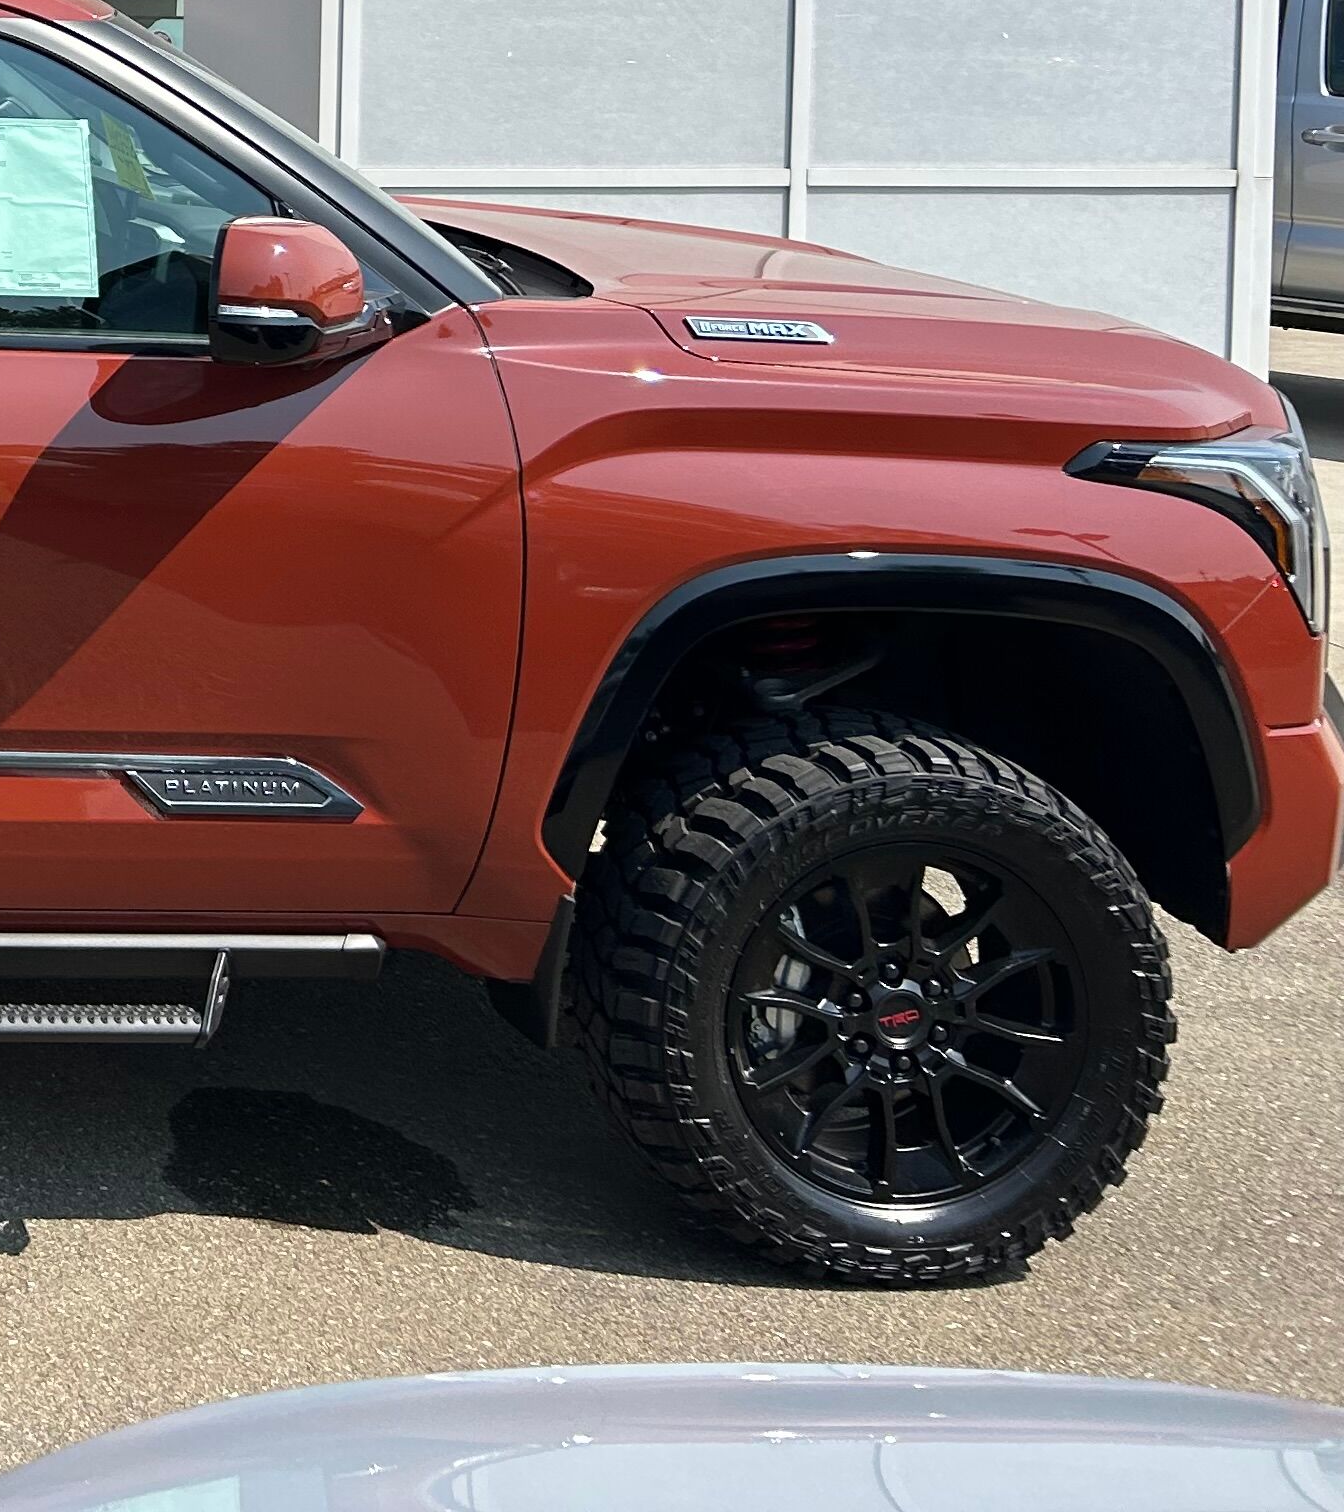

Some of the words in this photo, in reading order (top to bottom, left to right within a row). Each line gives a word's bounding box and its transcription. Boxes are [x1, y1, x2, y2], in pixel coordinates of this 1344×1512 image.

[747, 322, 808, 337] MAX
[165, 779, 301, 796] PLATINUM
[878, 1009, 920, 1028] TRD
